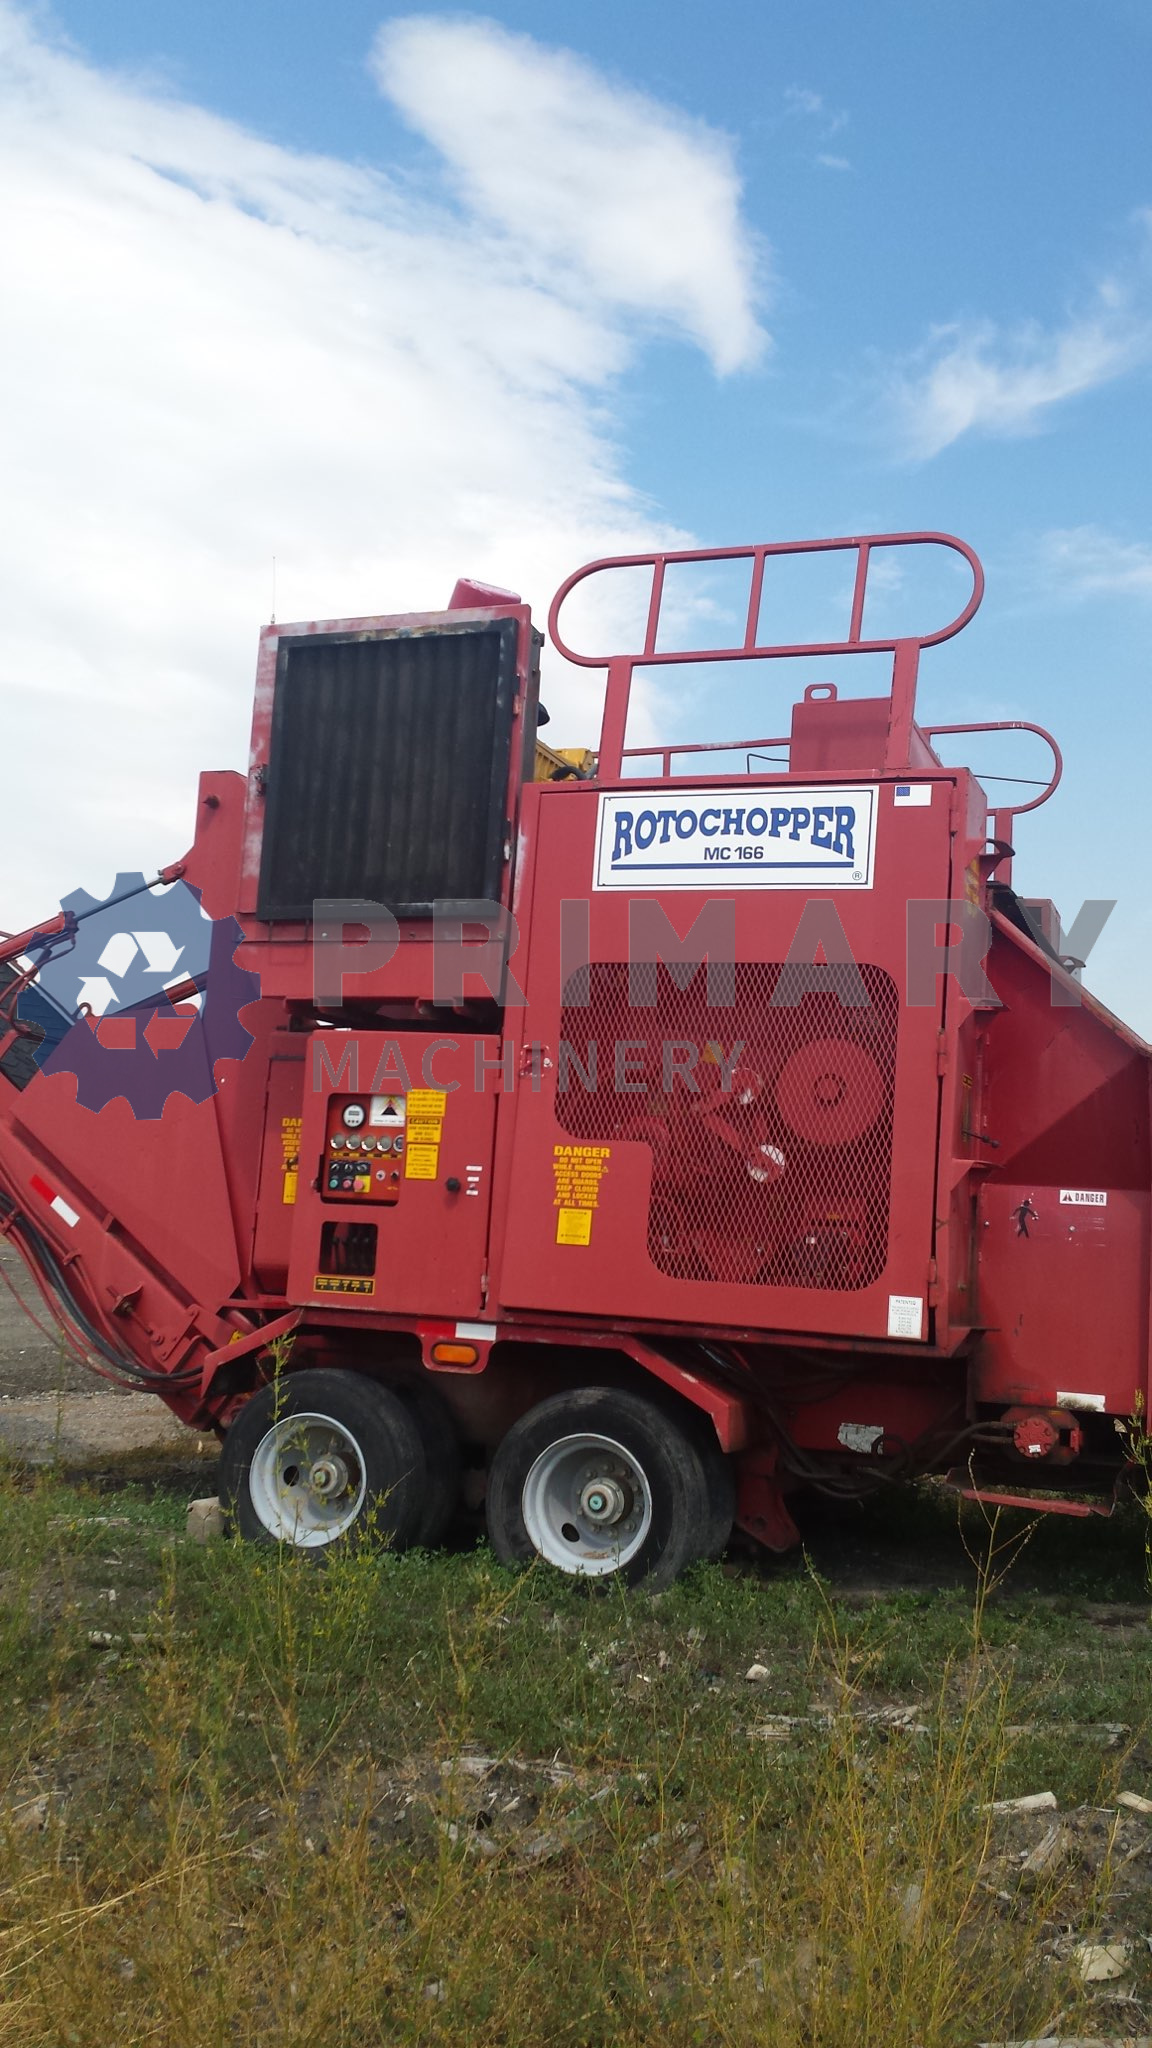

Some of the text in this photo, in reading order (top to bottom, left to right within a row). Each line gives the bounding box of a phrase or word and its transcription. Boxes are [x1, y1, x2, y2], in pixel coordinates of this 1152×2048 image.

[611, 806, 856, 862] ROTOCHOPPER
[704, 845, 764, 860] MC 166
[553, 1145, 611, 1158] DANGER
[1075, 1192, 1105, 1204] DANGER
